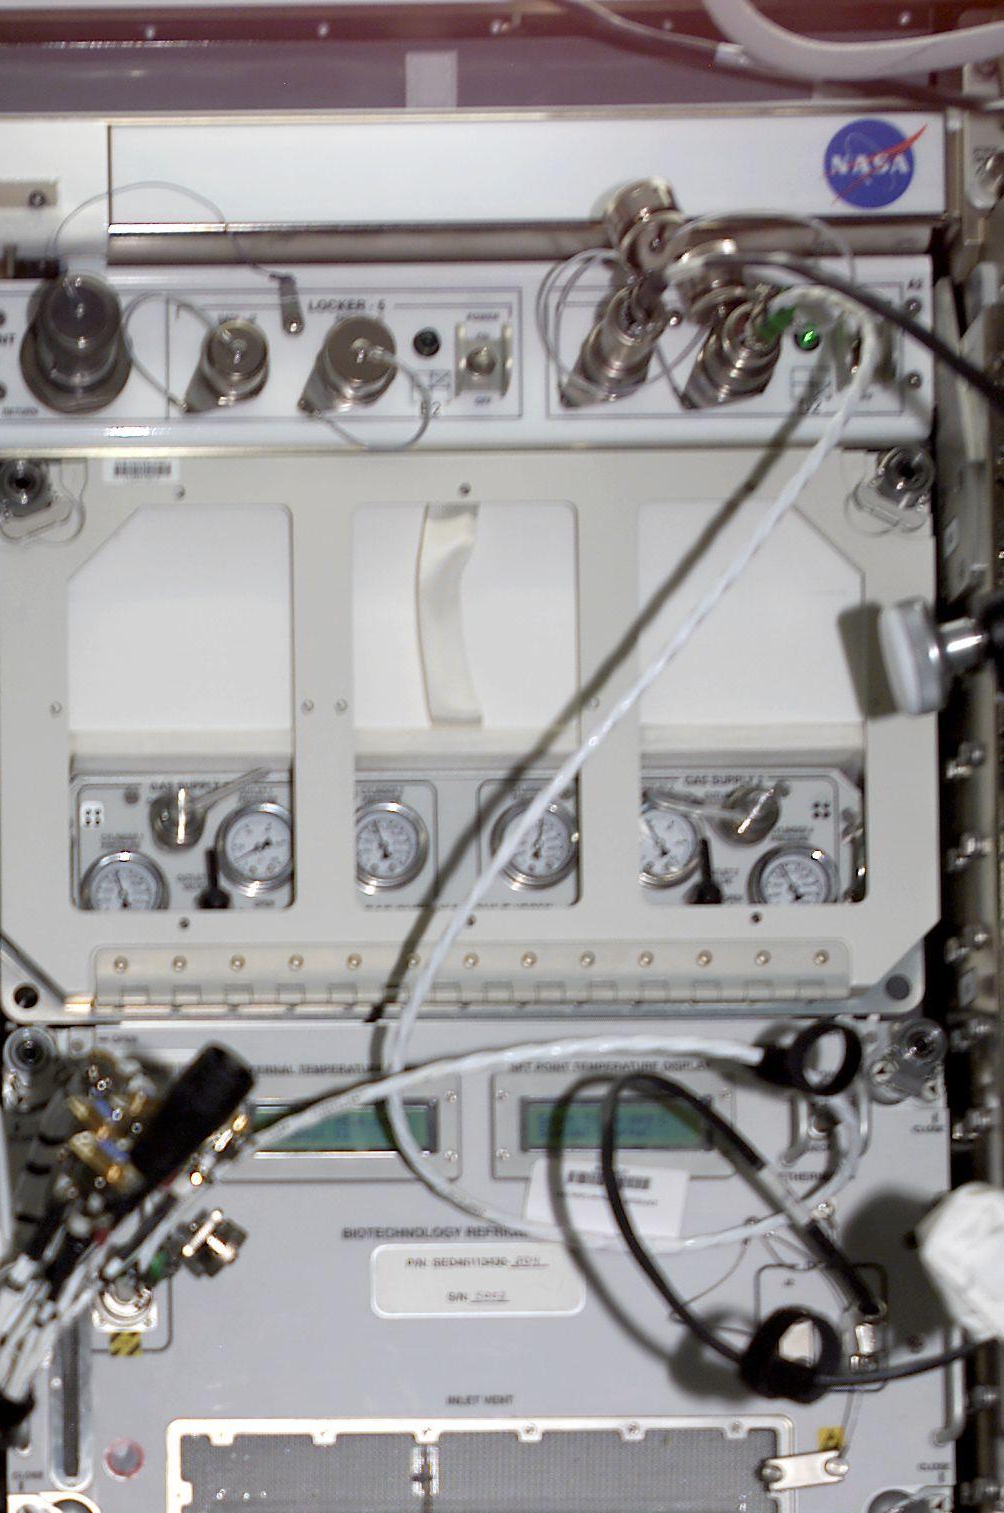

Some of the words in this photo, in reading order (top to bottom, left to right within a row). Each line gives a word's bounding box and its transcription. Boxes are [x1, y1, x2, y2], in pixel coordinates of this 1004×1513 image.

[830, 152, 911, 175] NASA
[307, 300, 366, 311] LOCKER
[685, 775, 711, 786] GAS
[712, 775, 754, 786] SUPPLY
[341, 1226, 462, 1240] BIOTECHNOLOGY
